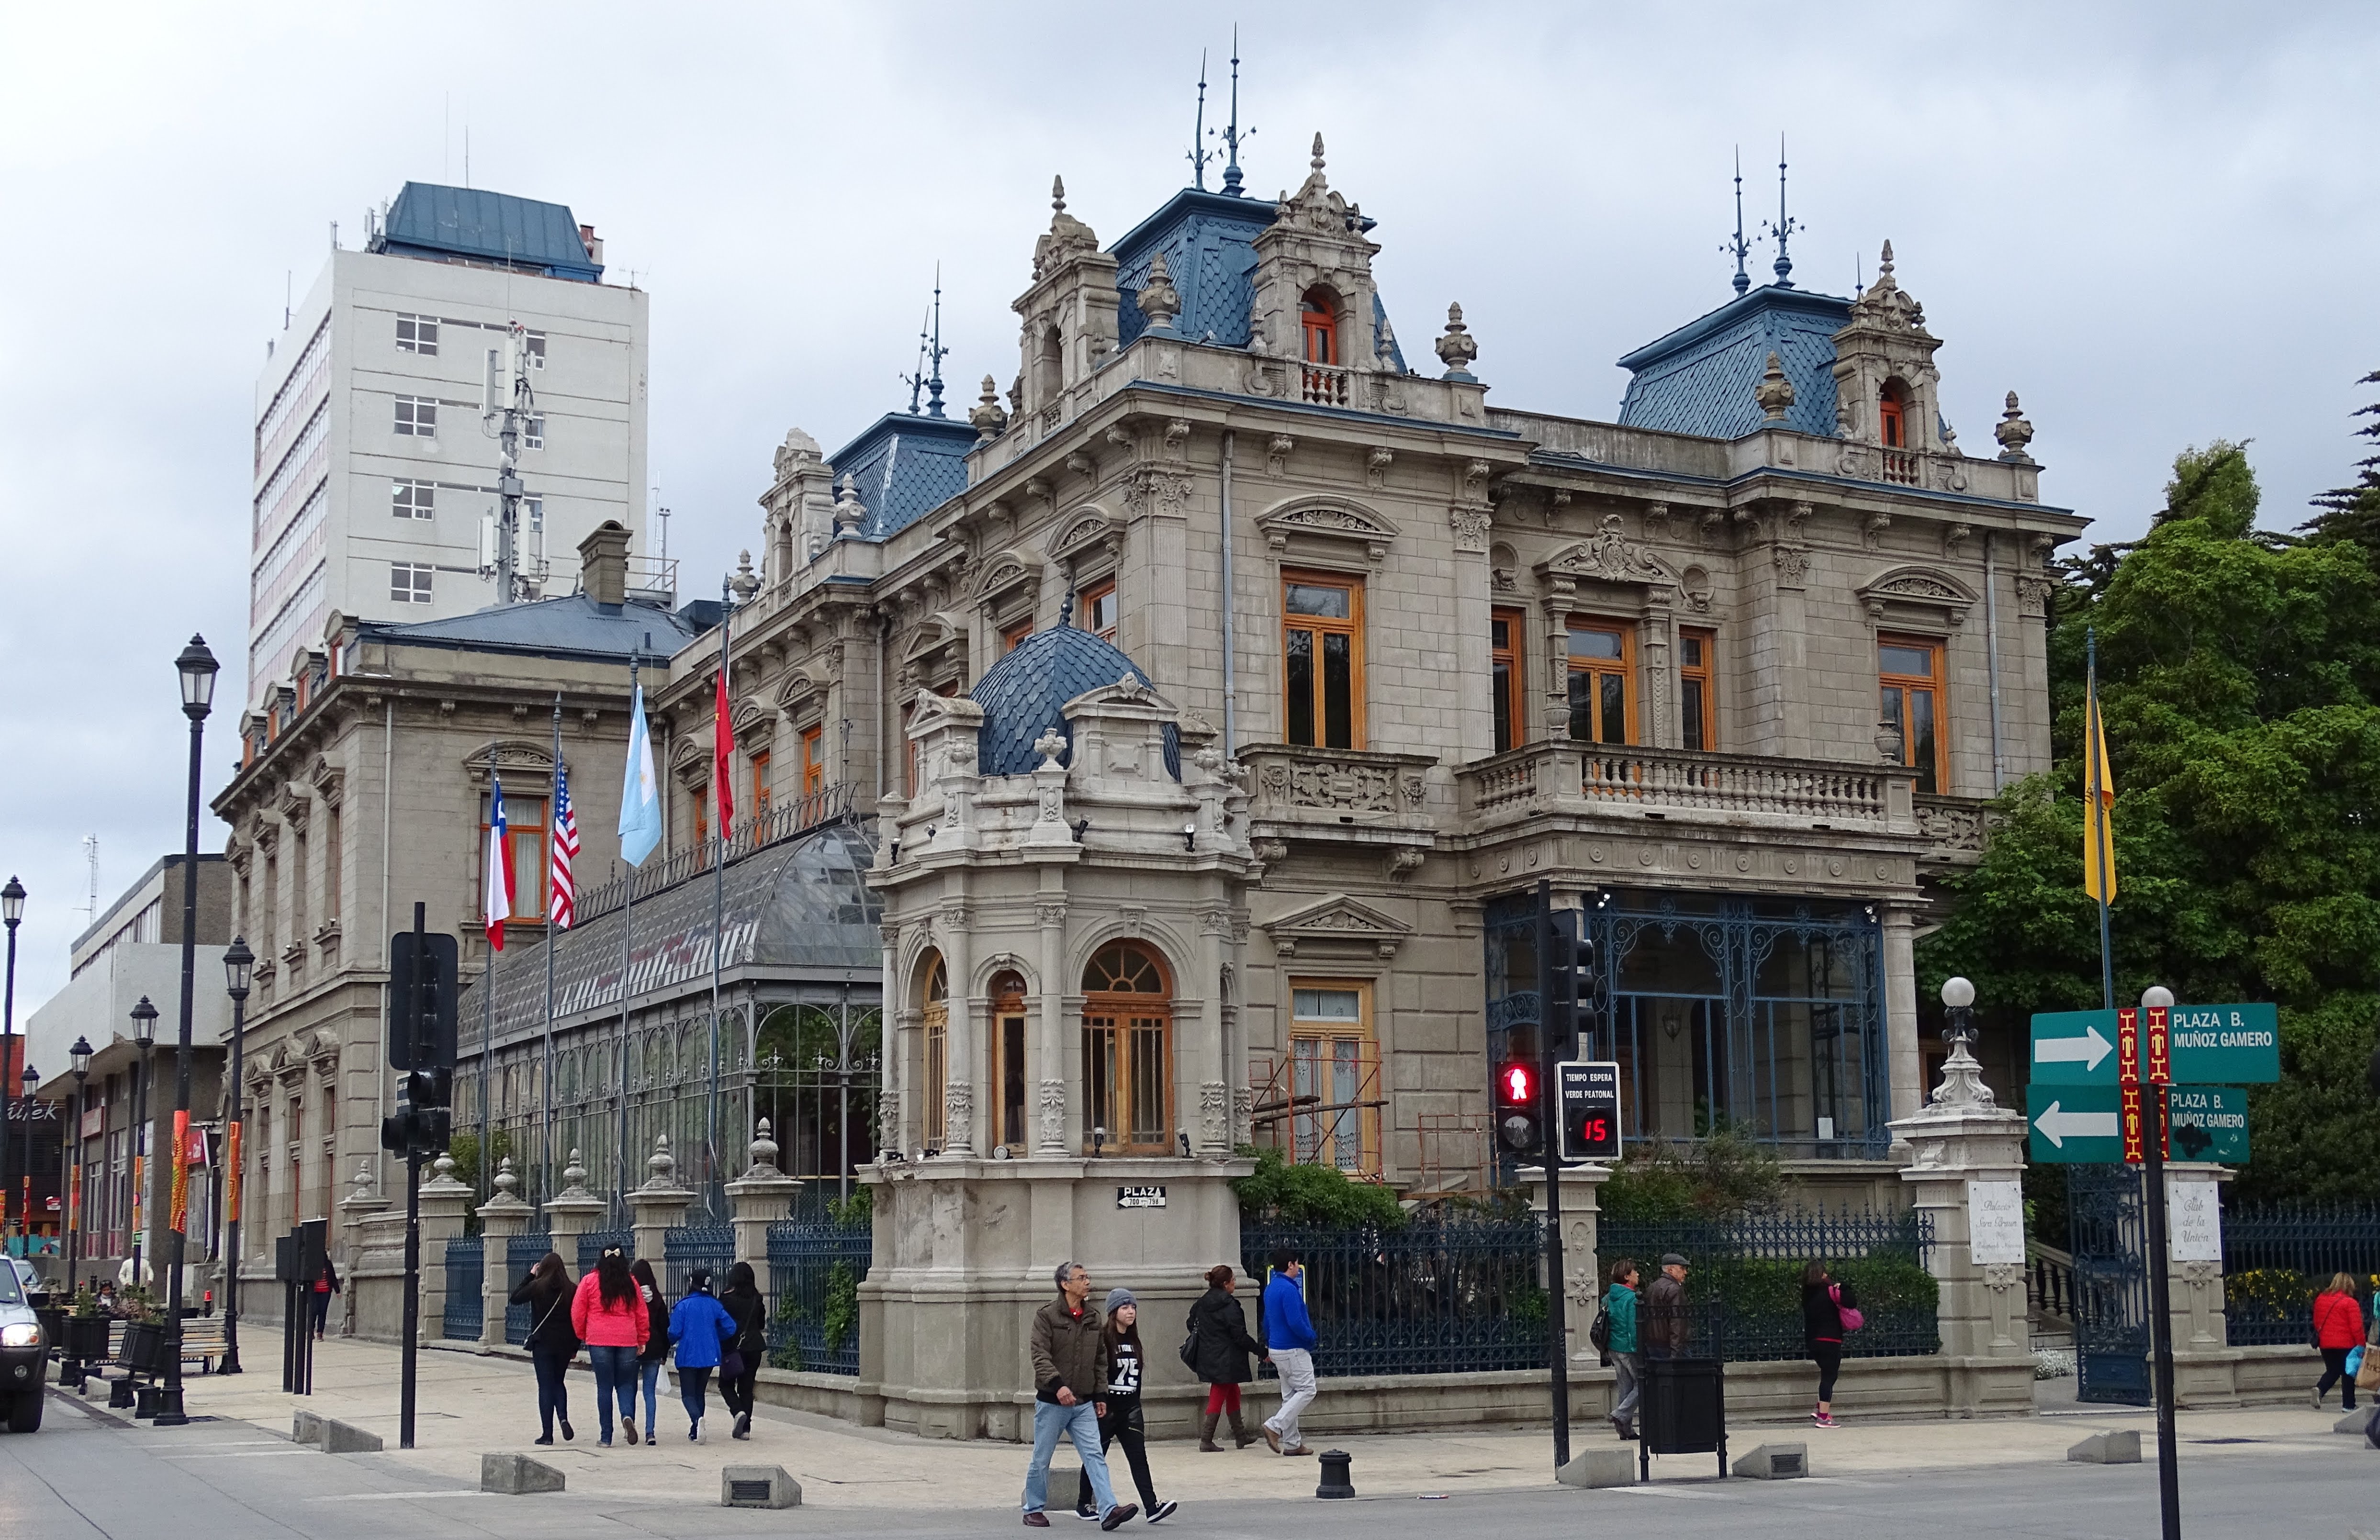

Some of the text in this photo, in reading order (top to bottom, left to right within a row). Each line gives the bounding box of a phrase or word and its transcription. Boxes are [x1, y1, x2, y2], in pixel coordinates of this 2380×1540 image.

[2173, 1012, 2244, 1028] PLAZA B.
[2174, 1030, 2272, 1048] MUÑOZ GAMERO
[1566, 1073, 1613, 1082] TIEMPO ESPERA
[1565, 1090, 1614, 1099] VERDE PEATONAL
[2171, 1093, 2224, 1109] PLAZA B.
[2172, 1111, 2245, 1128] MUÑOZ GAMERO
[1584, 1119, 1605, 1141] 15
[1124, 1187, 1161, 1196] PLAZA
[1981, 1199, 2014, 1212] Palacio
[2183, 1196, 2203, 1212] Club
[1976, 1216, 2017, 1228] Sara Braun
[2183, 1215, 2205, 1227] de la
[1114, 1358, 1139, 1386] 75
